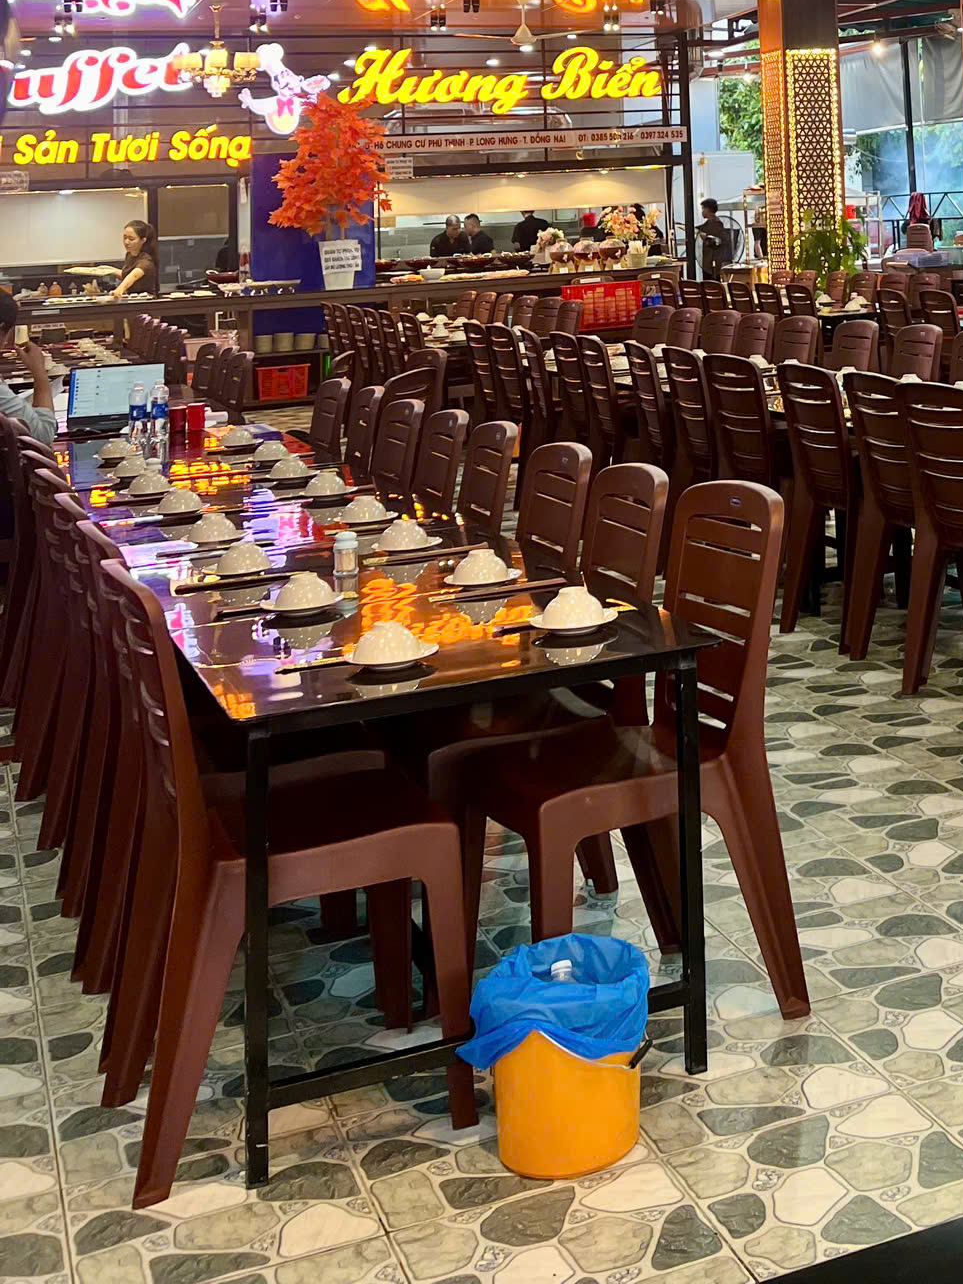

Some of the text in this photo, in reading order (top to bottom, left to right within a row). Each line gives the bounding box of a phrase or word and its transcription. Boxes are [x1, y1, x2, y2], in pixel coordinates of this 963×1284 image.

[3, 43, 193, 115] uffet
[337, 46, 662, 115] Hương Biển
[13, 129, 79, 165] Sản
[91, 131, 160, 163] Tươi
[168, 124, 252, 167] Sống
[386, 140, 412, 149] CHUNG
[476, 136, 495, 146] LONG
[641, 130, 655, 140] 0397
